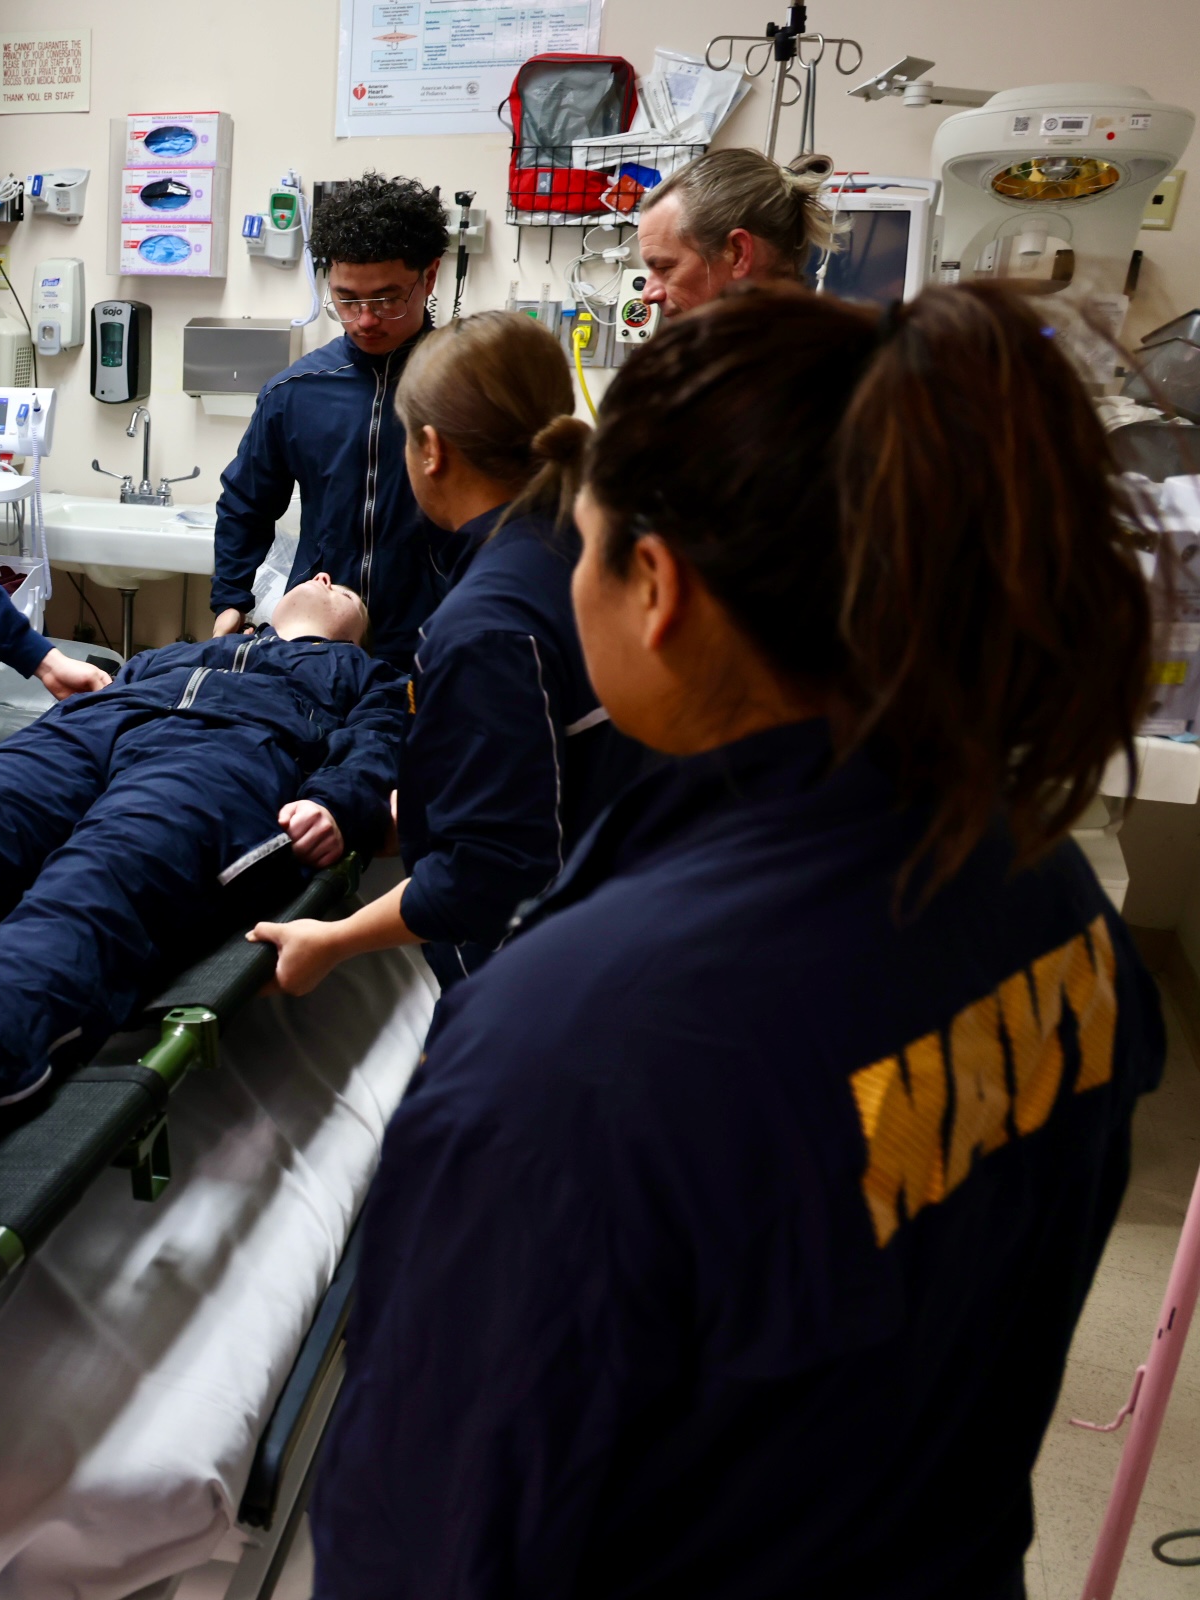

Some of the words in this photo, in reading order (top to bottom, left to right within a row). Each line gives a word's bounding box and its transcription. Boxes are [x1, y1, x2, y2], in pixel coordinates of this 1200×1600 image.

[3, 43, 11, 51] WE
[14, 42, 35, 51] CANNOT
[38, 40, 68, 50] GUARANTEE
[71, 40, 81, 49] THE
[3, 52, 21, 60] PRIVACY
[24, 51, 30, 59] OF
[32, 50, 44, 59] YOUR
[46, 49, 81, 58] CONVERSATION
[3, 60, 20, 68] PLEASE
[22, 59, 37, 68] NOTIFY
[40, 59, 48, 67] OUR
[51, 58, 64, 66] STAFF
[66, 58, 70, 66] IF
[72, 58, 81, 66] YOU
[3, 68, 19, 77] WOULD
[21, 68, 30, 76] LIKE
[39, 67, 57, 76] PRIVATE
[59, 66, 72, 75] ROOM
[75, 66, 81, 74] TO
[3, 77, 21, 86] DISCUSS
[24, 77, 35, 85] YOUR
[37, 76, 55, 84] MEDICAL
[58, 75, 81, 84] CONDITION
[44, 92, 52, 100] ER
[56, 92, 75, 100] STAFF
[850, 911, 1118, 1250] NAVY
